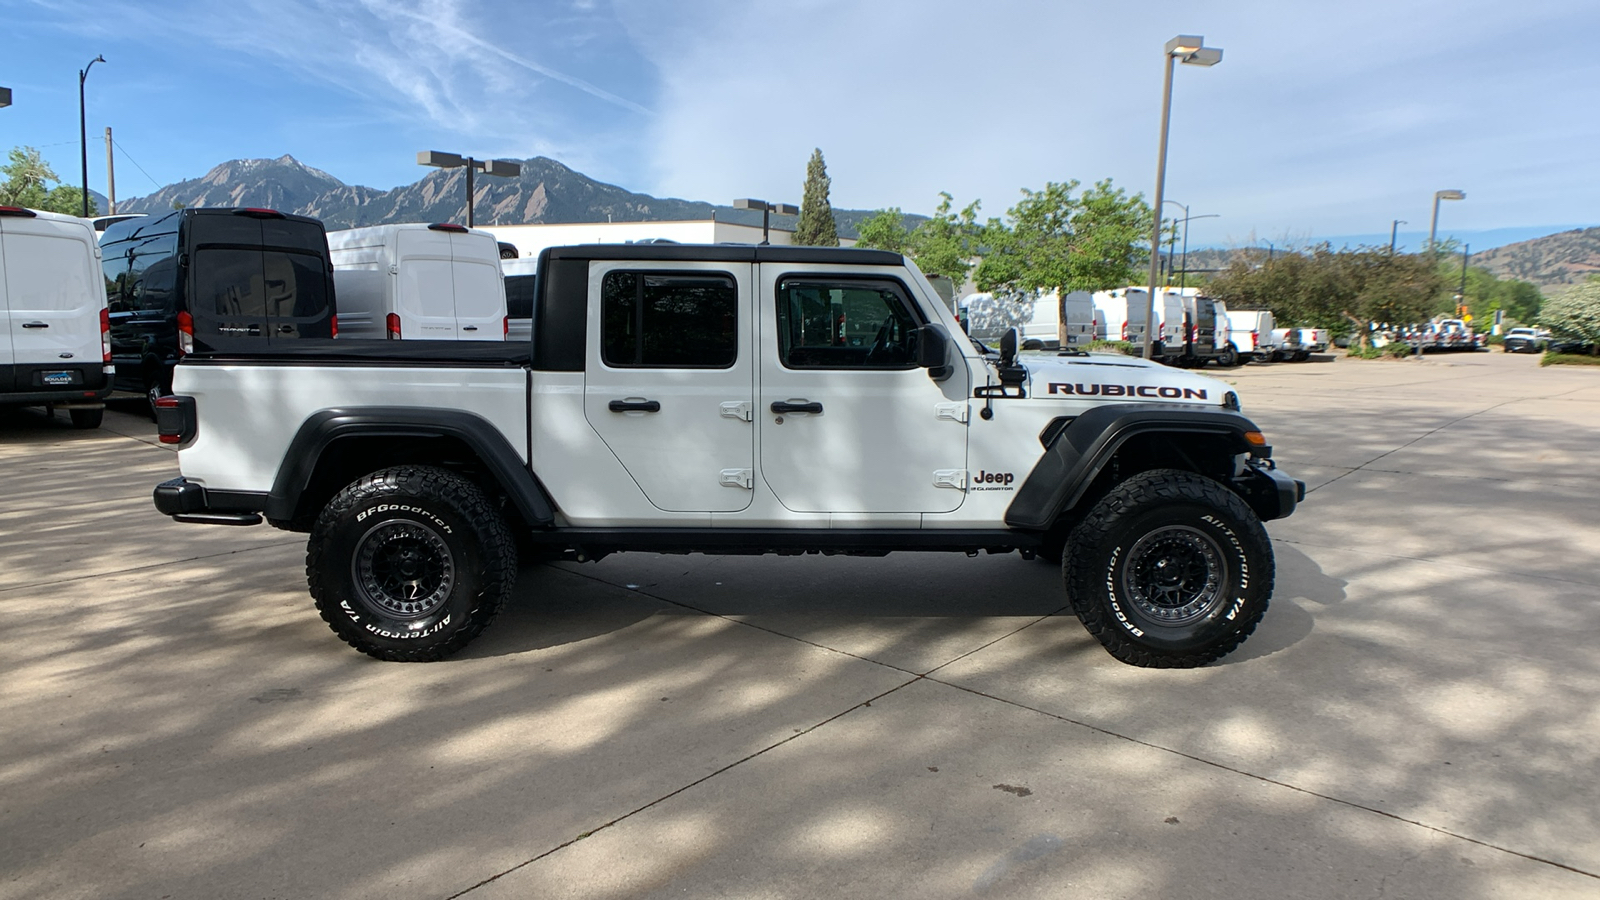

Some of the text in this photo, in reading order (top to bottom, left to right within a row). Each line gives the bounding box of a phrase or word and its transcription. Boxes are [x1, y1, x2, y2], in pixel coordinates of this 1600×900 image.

[1048, 382, 1208, 400] RUBICON
[974, 470, 1014, 486] Jeep
[356, 504, 452, 535] BFGoodrich
[1201, 514, 1251, 621] All-Terrain T/A
[1106, 546, 1144, 638] BFGoodrich
[340, 599, 452, 640] All-Terrain T/A
